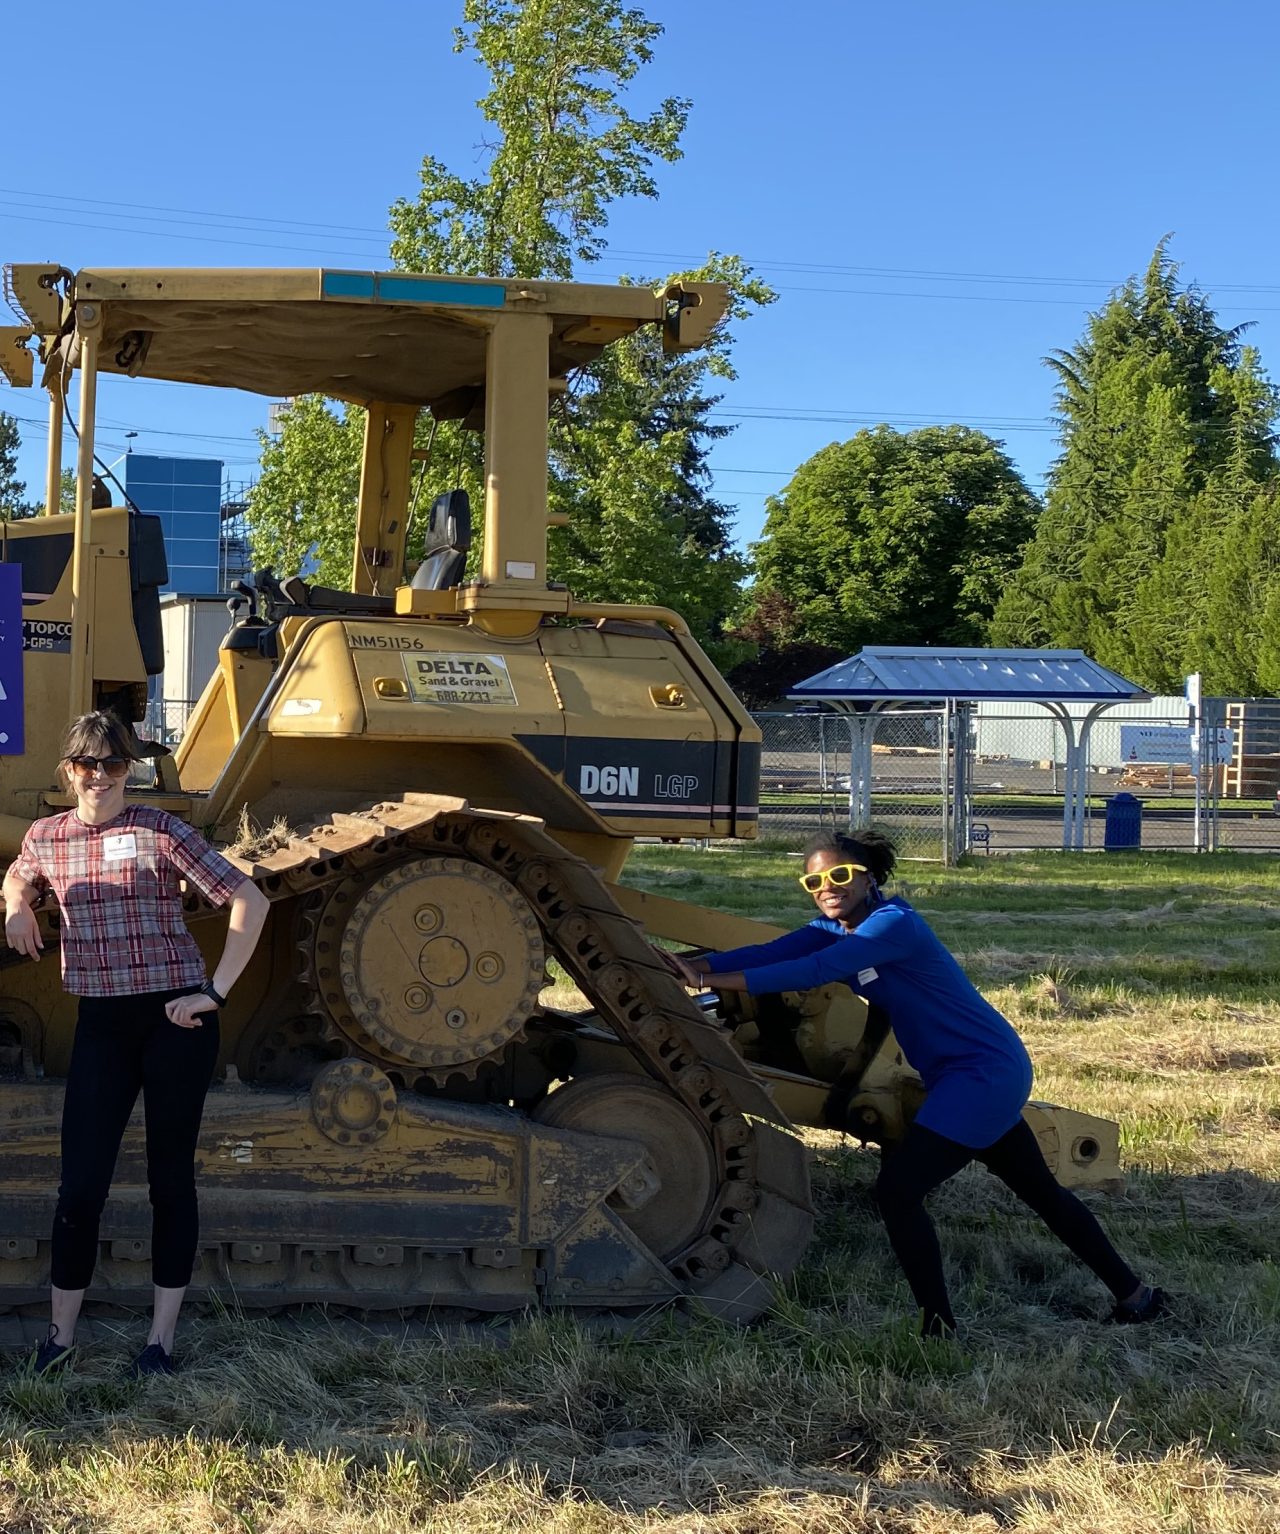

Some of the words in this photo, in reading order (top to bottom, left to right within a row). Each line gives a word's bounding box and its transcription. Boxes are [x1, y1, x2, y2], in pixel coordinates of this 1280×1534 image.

[351, 635, 424, 650] NM51156
[416, 660, 492, 675] DELTA
[418, 676, 447, 686] Sand
[448, 677, 459, 686] &
[460, 677, 499, 687] Gravel
[580, 765, 639, 796] D6N
[654, 774, 699, 798] LGP
